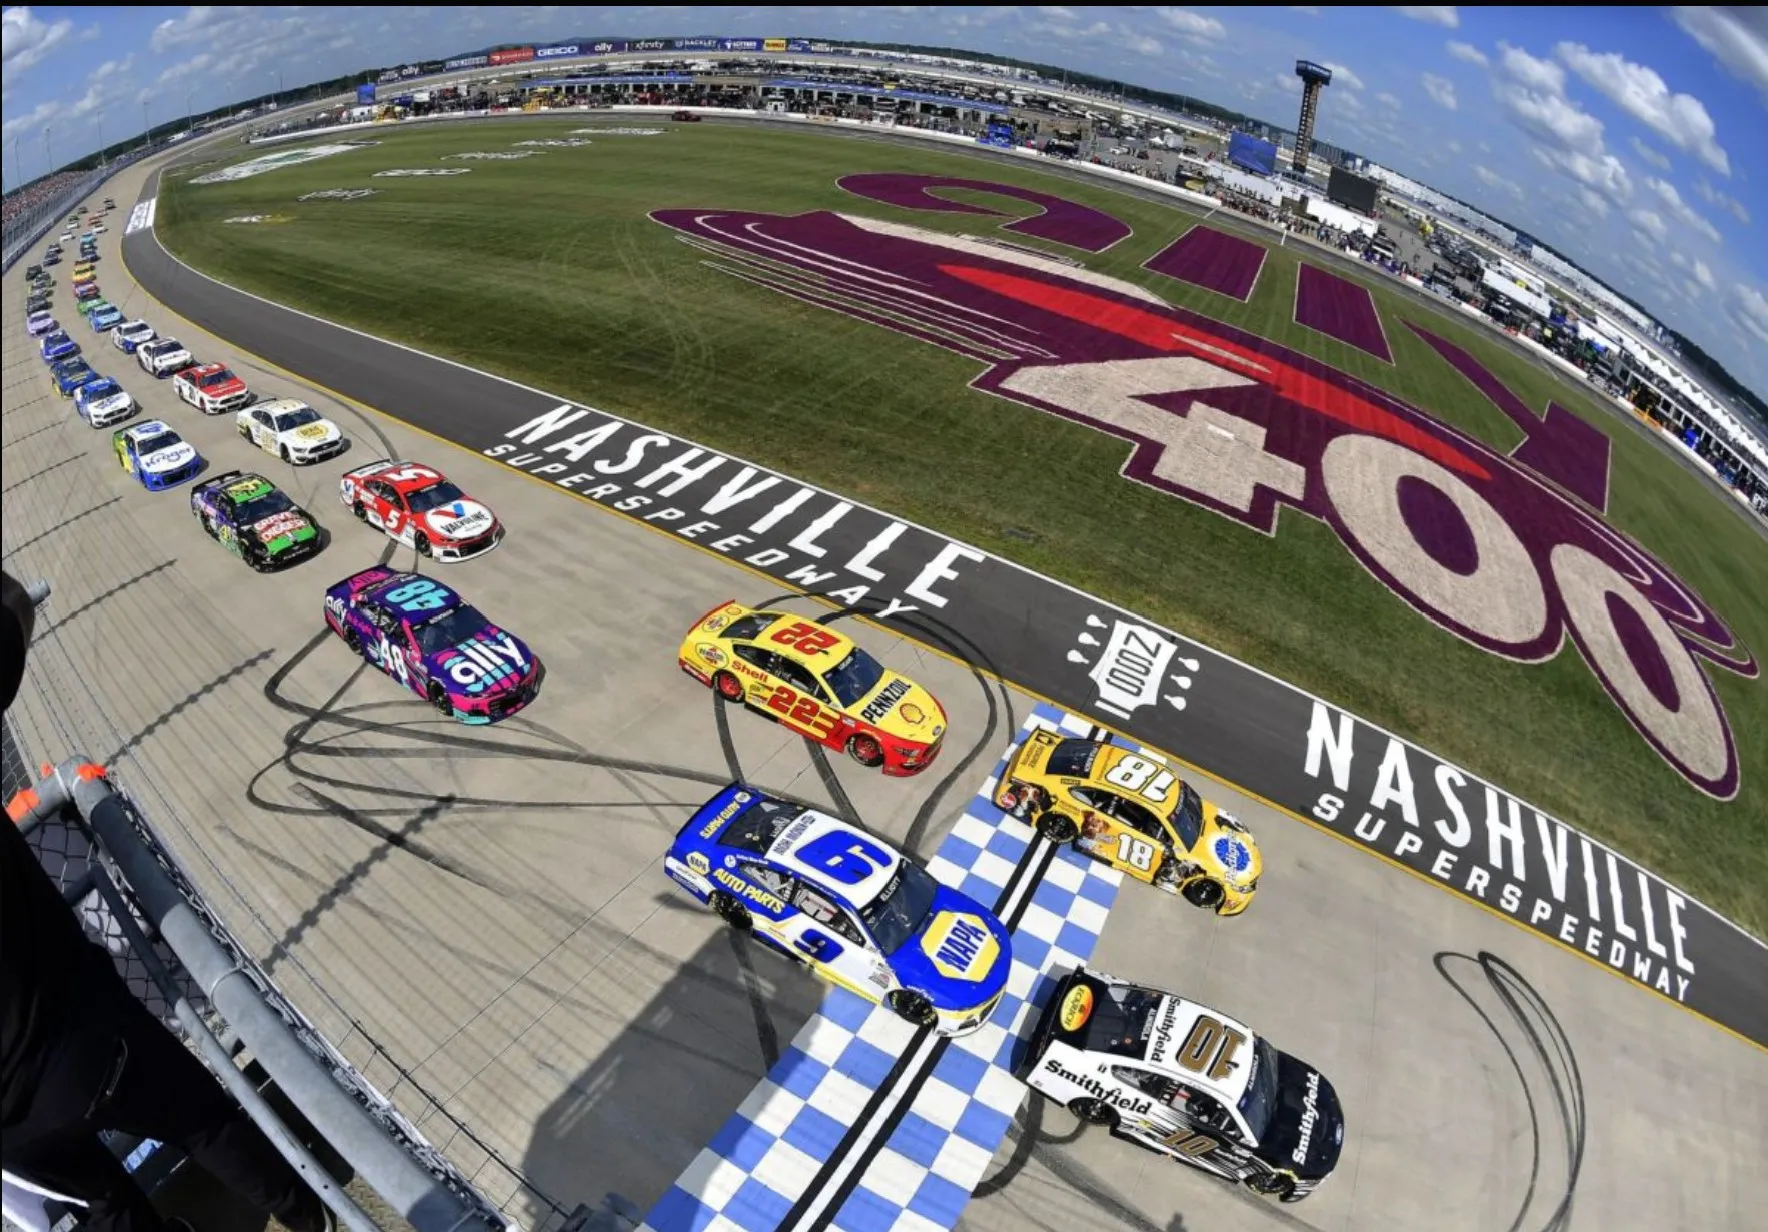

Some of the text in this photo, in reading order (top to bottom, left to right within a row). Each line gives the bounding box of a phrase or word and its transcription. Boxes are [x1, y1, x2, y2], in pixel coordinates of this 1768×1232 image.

[537, 45, 578, 57] GEICO
[594, 43, 613, 53] ally
[145, 447, 191, 468] Kroger
[385, 509, 401, 528] 5
[440, 511, 489, 535] VALVOLINE
[505, 403, 986, 609] NASHVILLE
[483, 443, 919, 620] SUPERSPEEDWAY
[385, 580, 450, 611] 48
[998, 356, 1737, 800] 400
[325, 596, 348, 625] ally
[380, 631, 409, 681] 48
[450, 637, 526, 685] ally
[770, 622, 841, 656] 22
[731, 659, 769, 683] Shell
[767, 685, 821, 726] 22
[860, 677, 912, 725] PENNZOIL
[1105, 754, 1176, 803] 18
[795, 830, 893, 885] 9
[1117, 833, 1154, 871] 18
[1304, 700, 1697, 975] NASHVILLE
[689, 855, 707, 871] NAPA
[713, 868, 746, 893] AUTO
[742, 885, 785, 914] PARTS
[880, 876, 901, 901] ELLIOTT
[1312, 795, 1691, 1002] SUPERSPEEDWAY
[793, 928, 845, 963] 9
[936, 919, 987, 973] NAPA
[1151, 996, 1181, 1063] Smithfield
[1176, 1014, 1247, 1082] 10
[1044, 1059, 1151, 1115] Smithfield
[1160, 1126, 1219, 1157] 10
[1292, 1072, 1320, 1166] Smithfield
